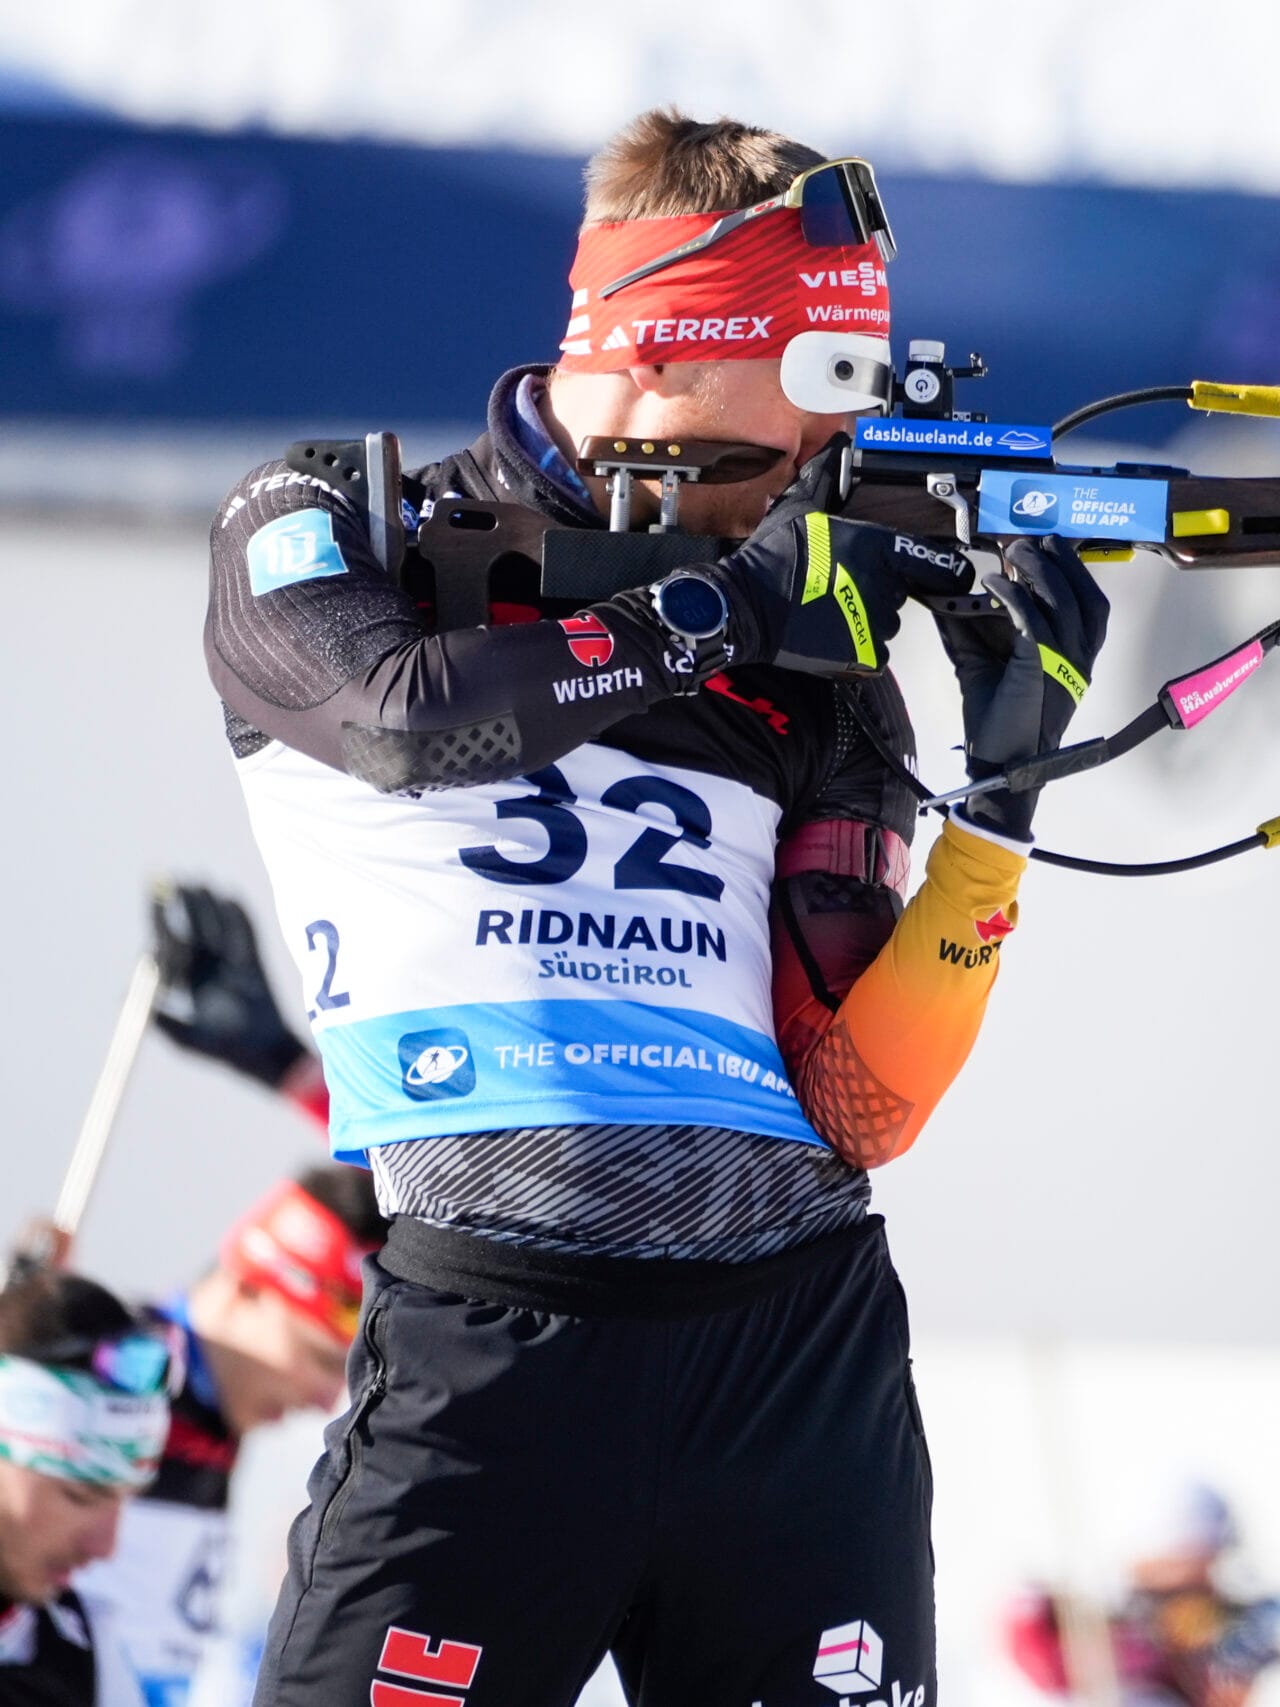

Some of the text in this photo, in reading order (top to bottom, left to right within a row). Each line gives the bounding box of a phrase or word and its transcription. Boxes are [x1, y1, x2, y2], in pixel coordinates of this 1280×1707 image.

[632, 316, 773, 344] TERREX
[863, 425, 993, 447] dasblaueland.de
[1071, 500, 1137, 514] OFFICIAL
[1072, 487, 1098, 500] THE
[1070, 512, 1130, 527] IBU APP
[552, 666, 643, 704] WÜRTH
[459, 762, 725, 903] 32
[475, 909, 728, 963] RIDNAUN
[495, 1042, 555, 1069] THE
[564, 1043, 712, 1072] OFFICIAL
[717, 1052, 760, 1083] IBU
